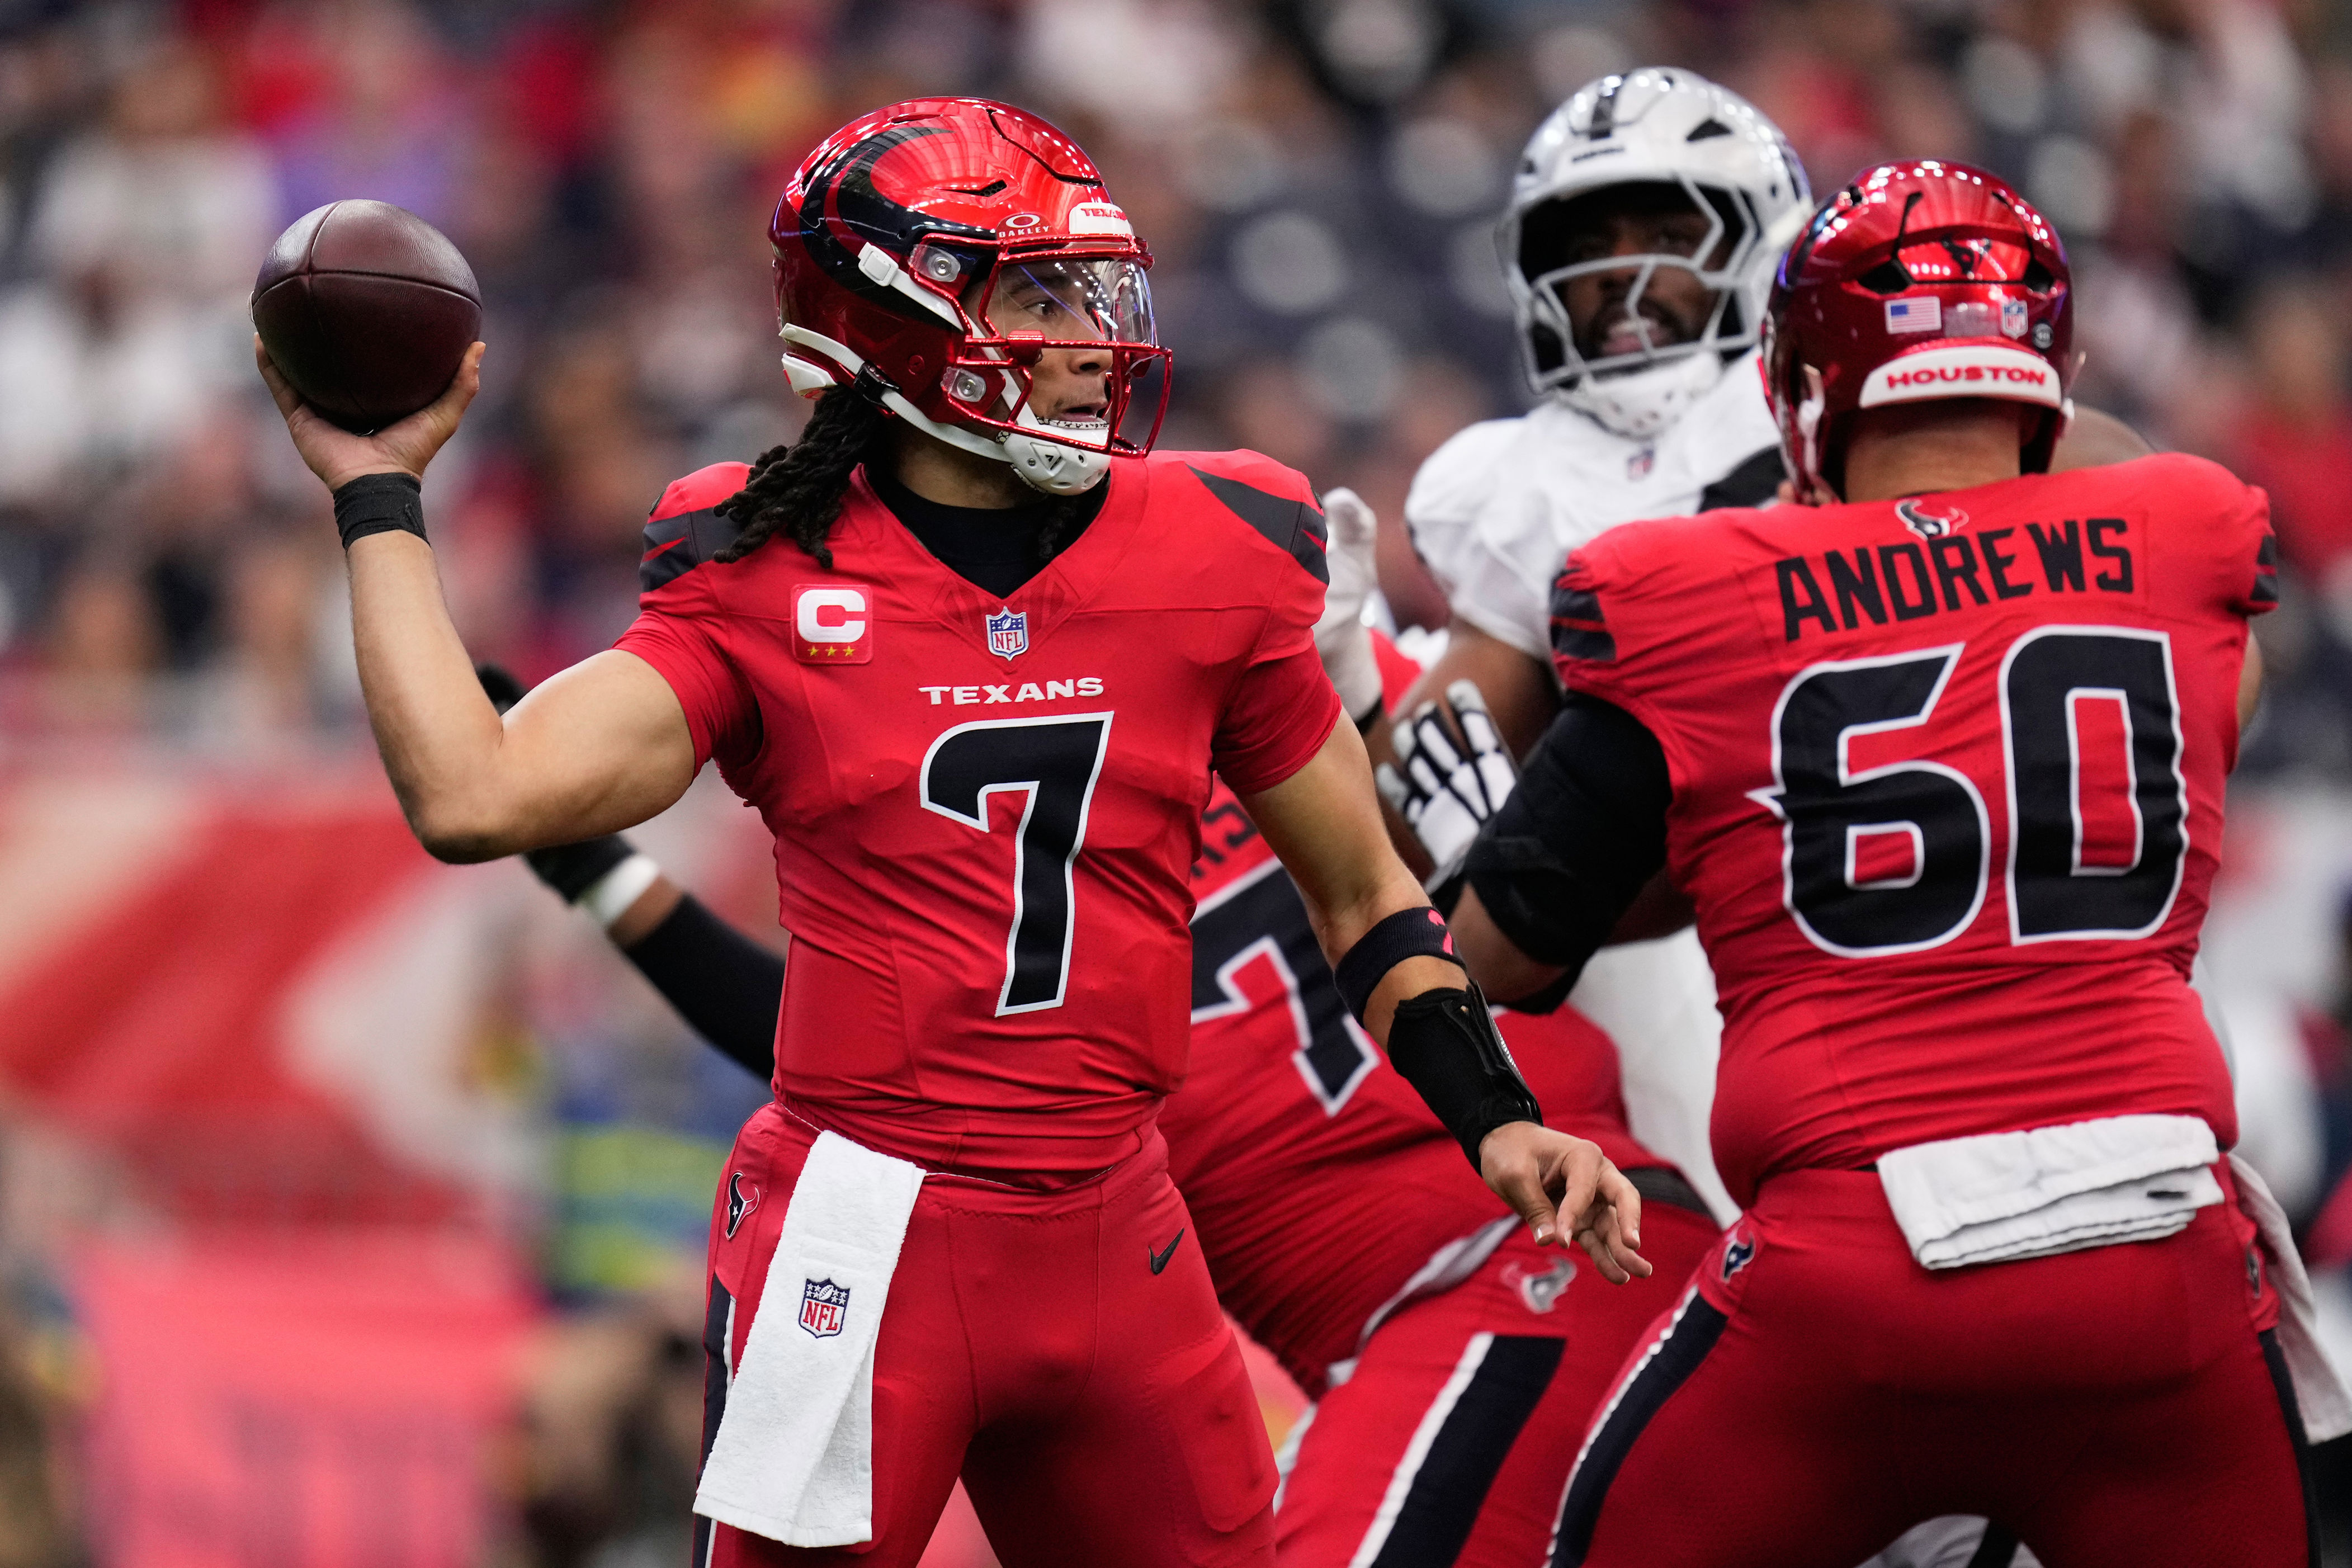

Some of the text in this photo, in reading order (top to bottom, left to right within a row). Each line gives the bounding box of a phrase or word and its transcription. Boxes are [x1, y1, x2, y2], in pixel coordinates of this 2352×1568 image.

[998, 226, 1050, 238] OAKLEY
[1886, 366, 2046, 389] HOUSTON
[1775, 518, 2133, 643] ANDREWS
[797, 589, 866, 643] C
[994, 632, 1022, 651] NFL
[918, 677, 1104, 705] TEXANS
[1746, 624, 2190, 958] 60
[919, 711, 1114, 1018] 7
[802, 1300, 839, 1331] NFL
